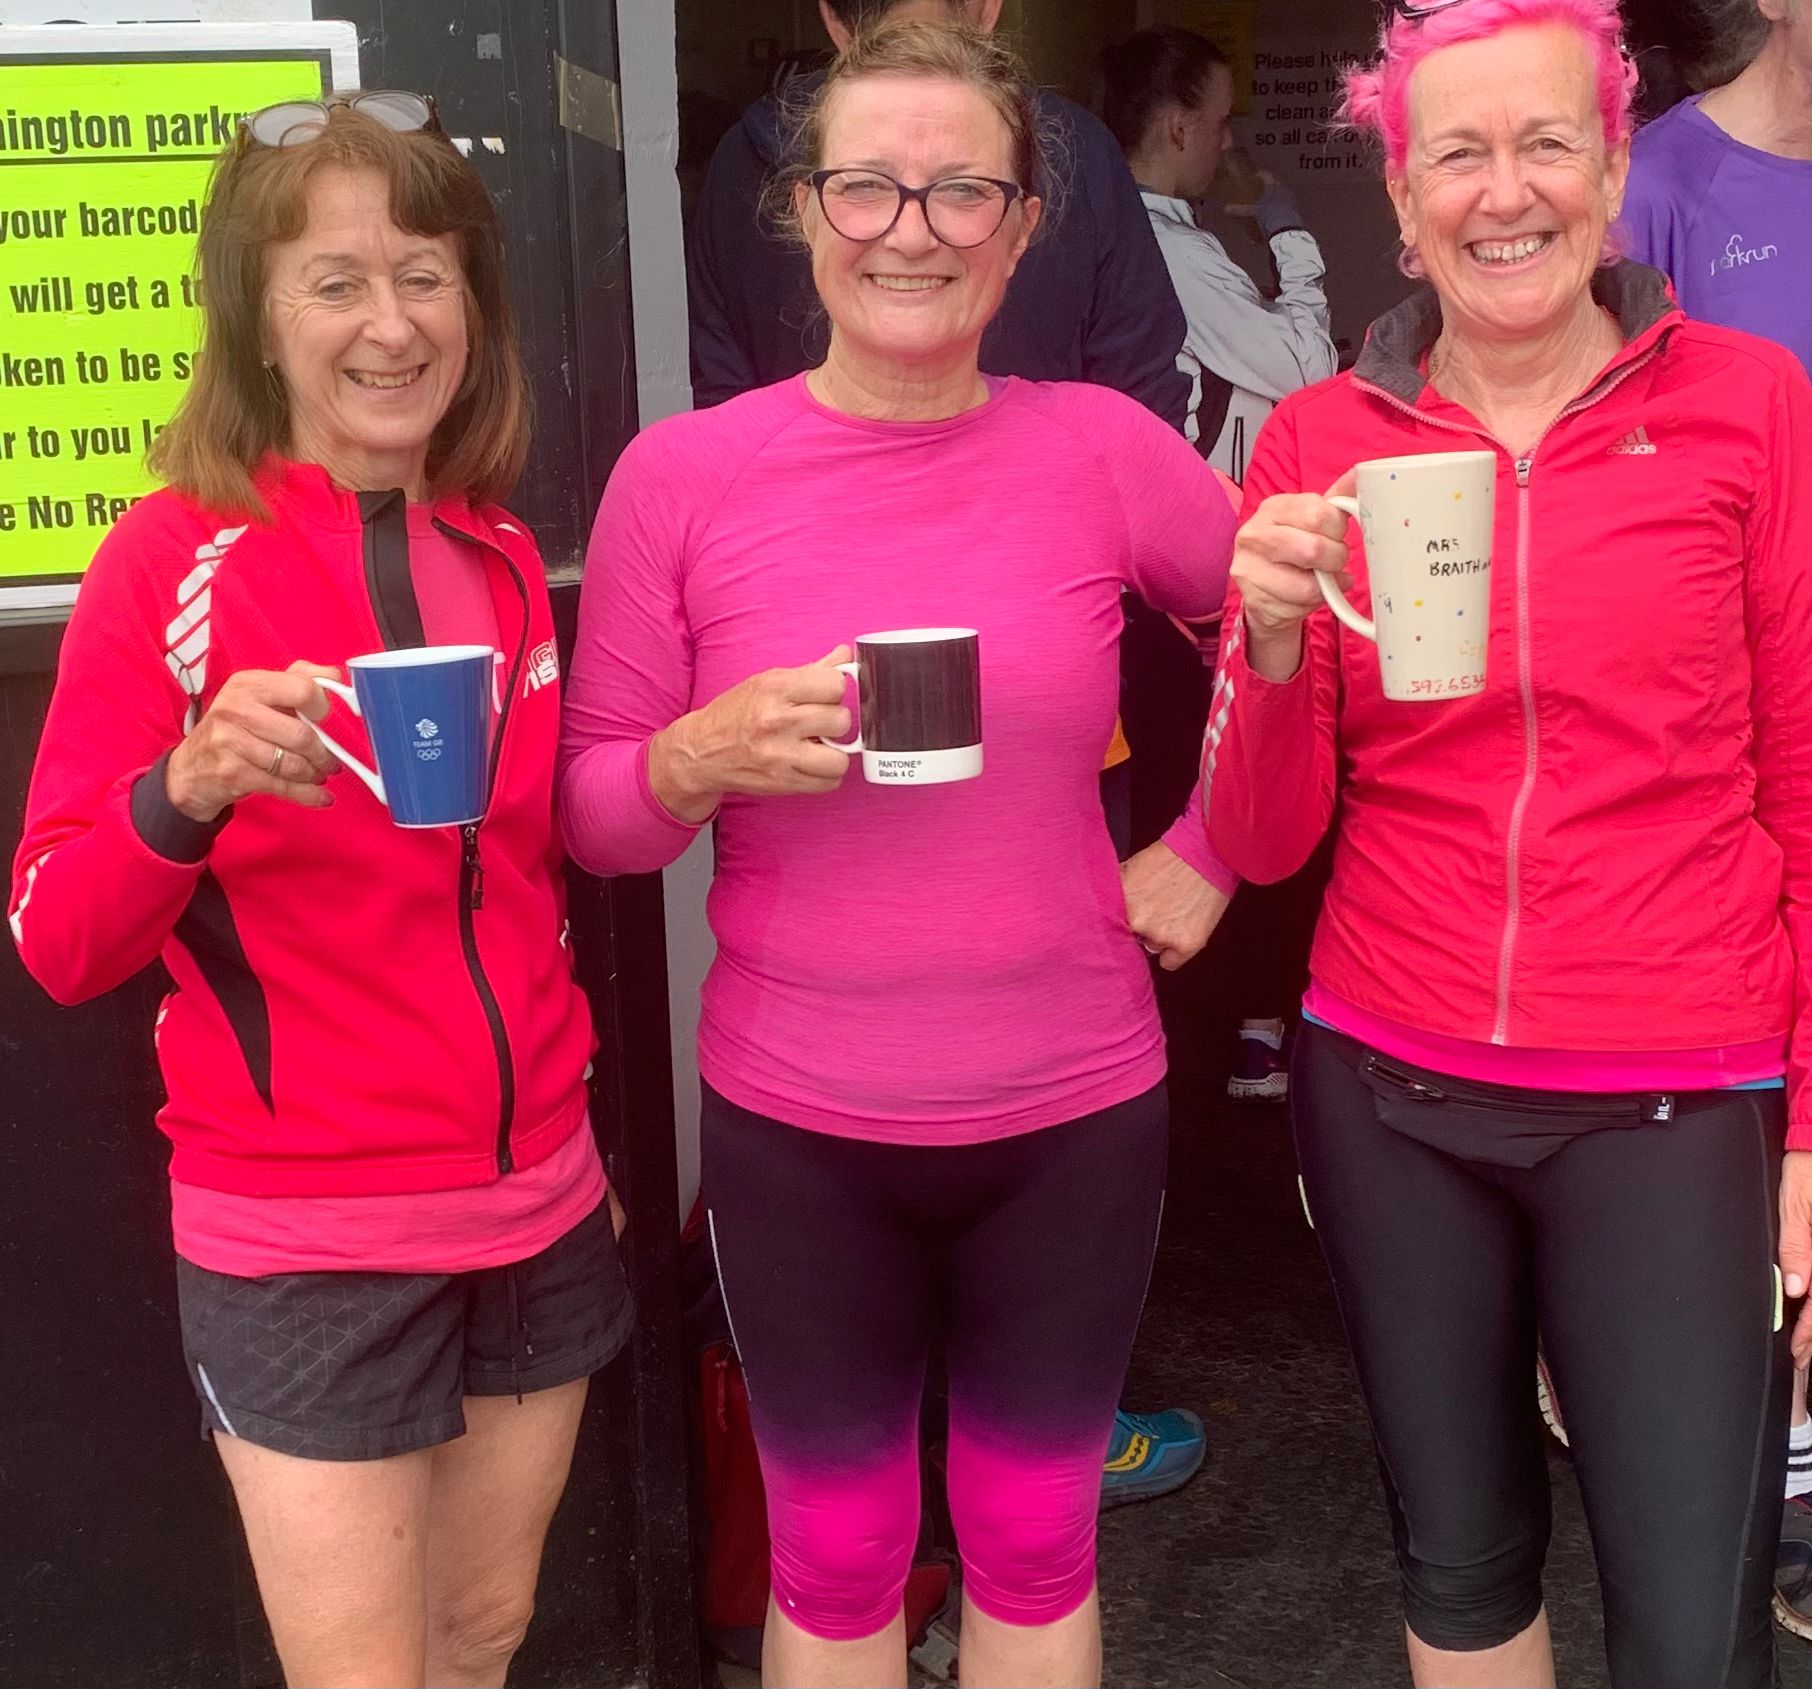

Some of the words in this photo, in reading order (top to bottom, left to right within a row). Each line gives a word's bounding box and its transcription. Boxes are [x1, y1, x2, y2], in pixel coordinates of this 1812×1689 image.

[1255, 53, 1314, 69] Please
[1274, 79, 1319, 97] keep
[1266, 104, 1315, 120] clean
[0, 109, 132, 154] ington
[1255, 132, 1277, 146] so
[1282, 129, 1302, 145] all
[1299, 153, 1341, 169] from
[79, 199, 200, 237] barcod
[9, 276, 73, 314] will
[85, 276, 140, 315] get
[150, 279, 170, 309] a
[0, 352, 66, 387] ken
[76, 351, 109, 384] to
[120, 348, 161, 382] be
[28, 425, 61, 458] to
[71, 427, 131, 461] you
[28, 495, 74, 529] No
[1426, 538, 1460, 553] MRS
[878, 769, 899, 777] Black
[901, 769, 905, 777] 4
[907, 769, 915, 777] C
